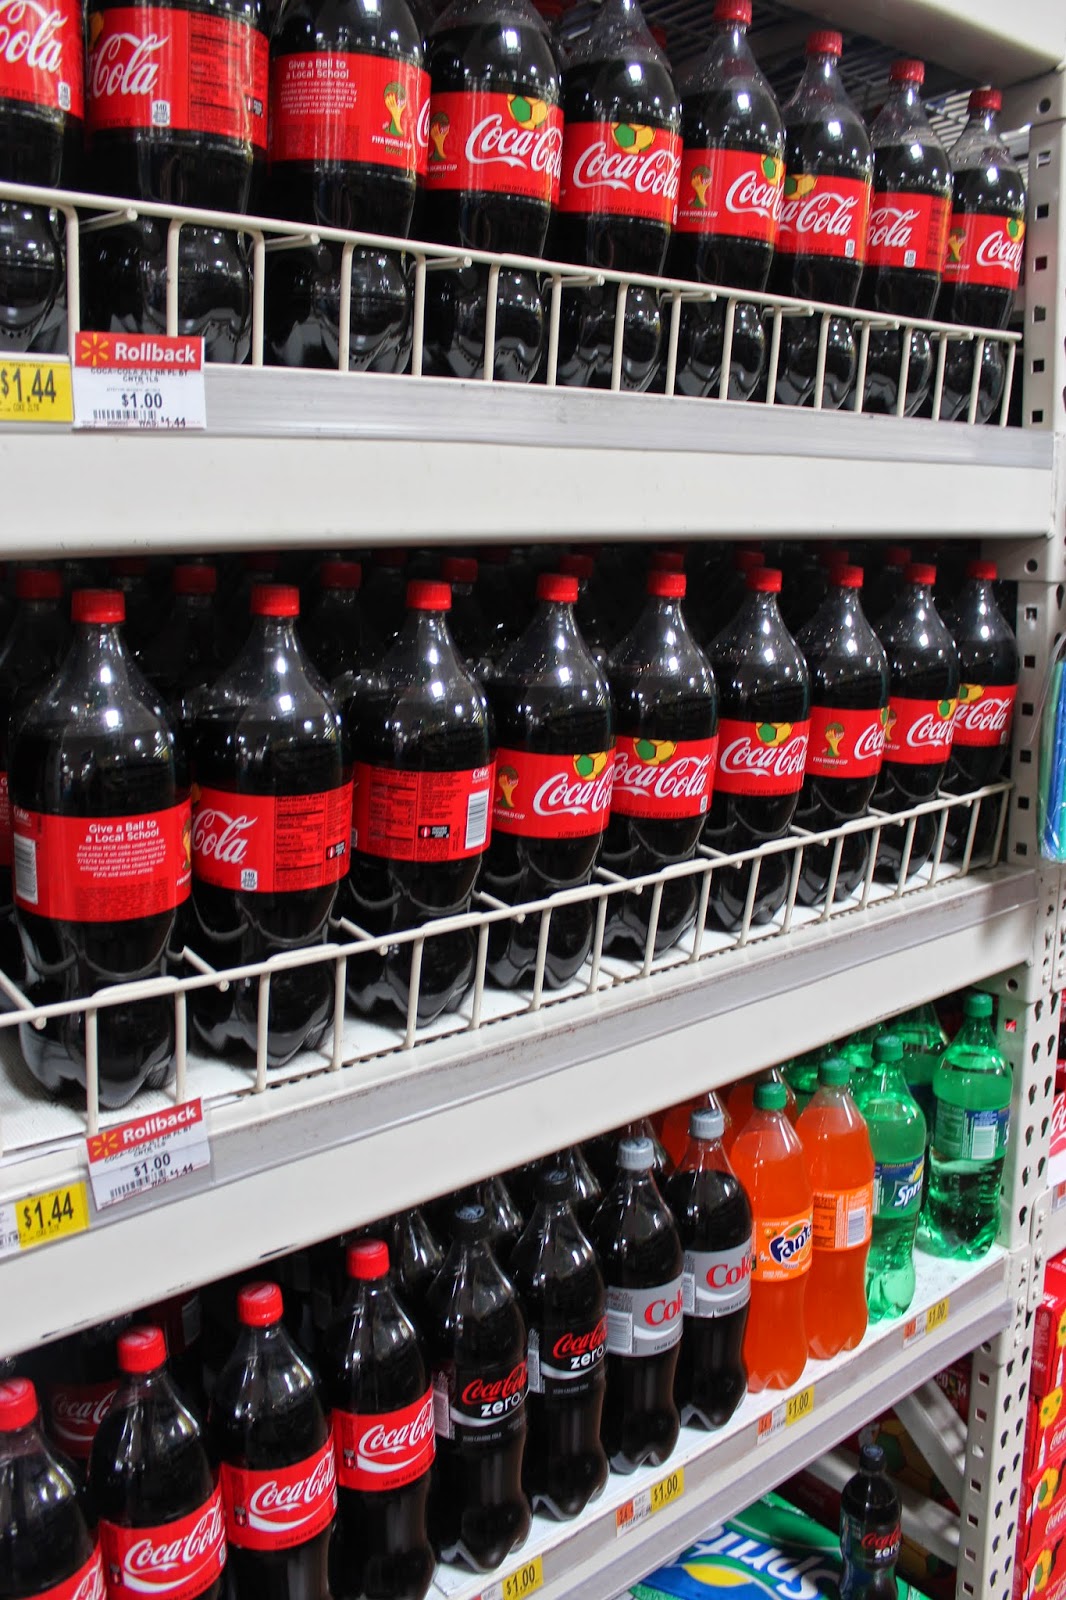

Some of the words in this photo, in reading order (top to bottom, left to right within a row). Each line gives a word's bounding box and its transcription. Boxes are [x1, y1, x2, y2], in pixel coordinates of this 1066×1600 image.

[286, 71, 291, 80] a
[292, 68, 314, 79] Local
[317, 68, 349, 79] School
[289, 60, 305, 70] Give
[308, 61, 313, 69] a
[316, 58, 332, 69] Ball
[336, 59, 346, 69] to
[371, 135, 384, 145] FIFA
[114, 342, 196, 363] Rollback
[0, 367, 57, 404] $1.44
[121, 391, 163, 410] $1.00
[85, 835, 92, 843] a
[95, 832, 124, 843] Local
[127, 826, 159, 842] School
[89, 823, 113, 834] Give
[116, 825, 122, 833] a
[125, 820, 144, 832] Ball
[147, 819, 157, 829] to
[122, 1105, 197, 1144] Rollback
[134, 1152, 171, 1177] $1.00
[24, 1190, 75, 1230] $1.44
[706, 1255, 751, 1290] Cok
[929, 1301, 946, 1325] $1.00
[571, 1344, 604, 1370] zero
[481, 1391, 521, 1418] zero
[789, 1392, 809, 1417] $1.00
[654, 1474, 678, 1503] $1.00
[688, 1531, 842, 1600] Sprit
[506, 1564, 536, 1597] $1.00
